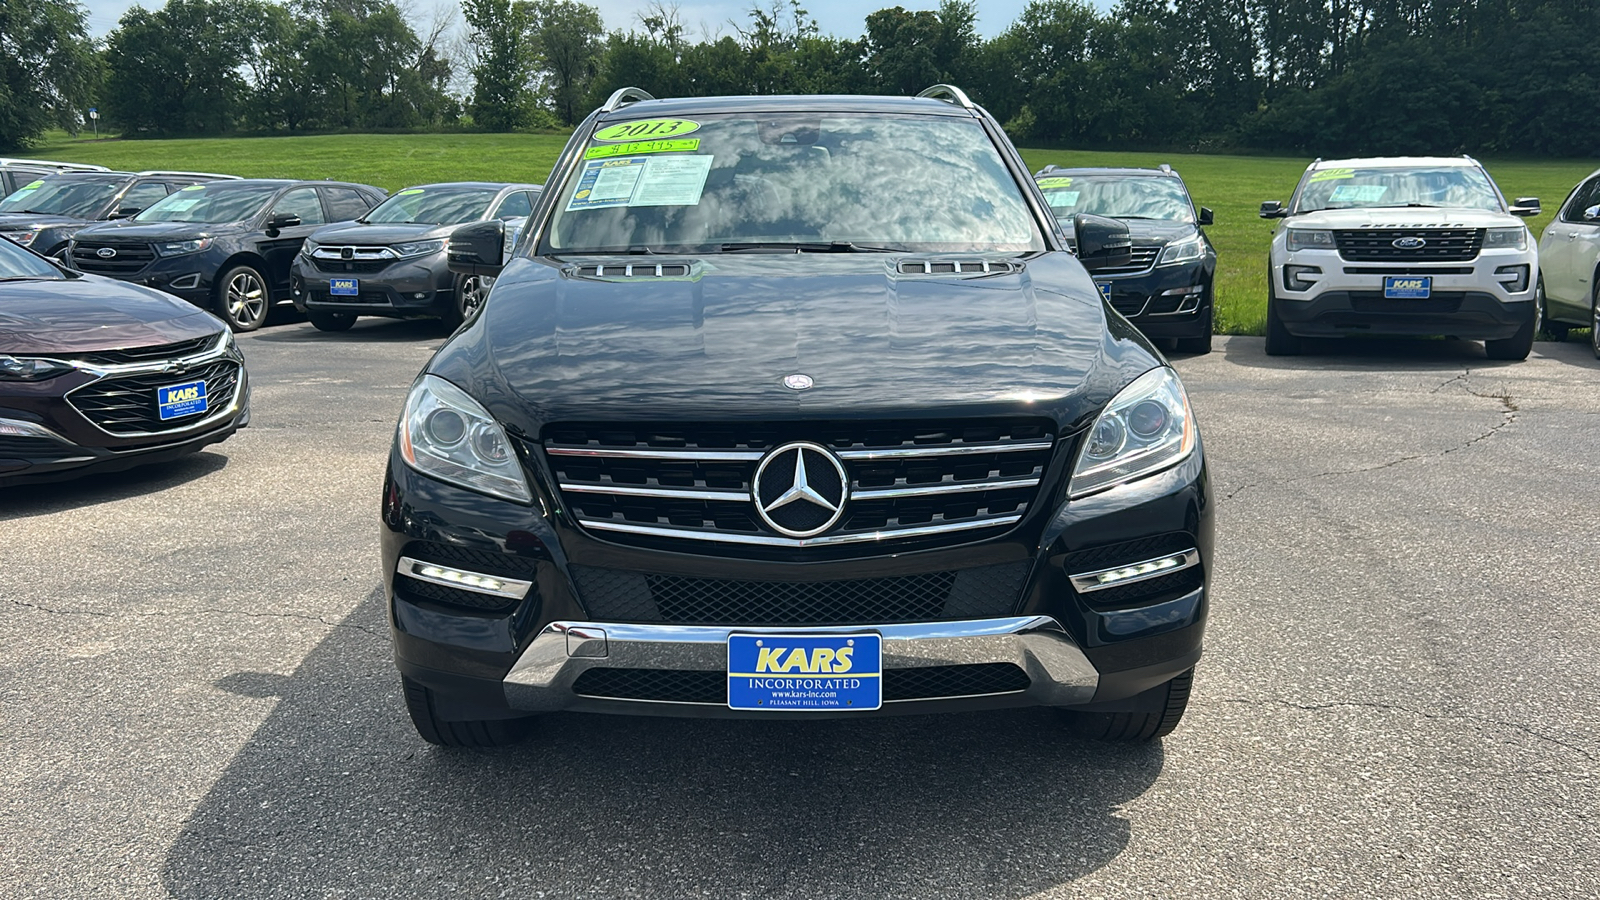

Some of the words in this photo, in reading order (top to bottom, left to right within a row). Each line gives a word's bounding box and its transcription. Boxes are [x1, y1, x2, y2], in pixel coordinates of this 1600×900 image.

[609, 121, 683, 139] 2013
[1400, 239, 1418, 247] Ford
[1393, 280, 1423, 289] KARS
[168, 386, 199, 403] KARS
[755, 647, 854, 673] KARS
[749, 678, 861, 689] INCORPORATED
[771, 690, 837, 698] www.kars-inc.com
